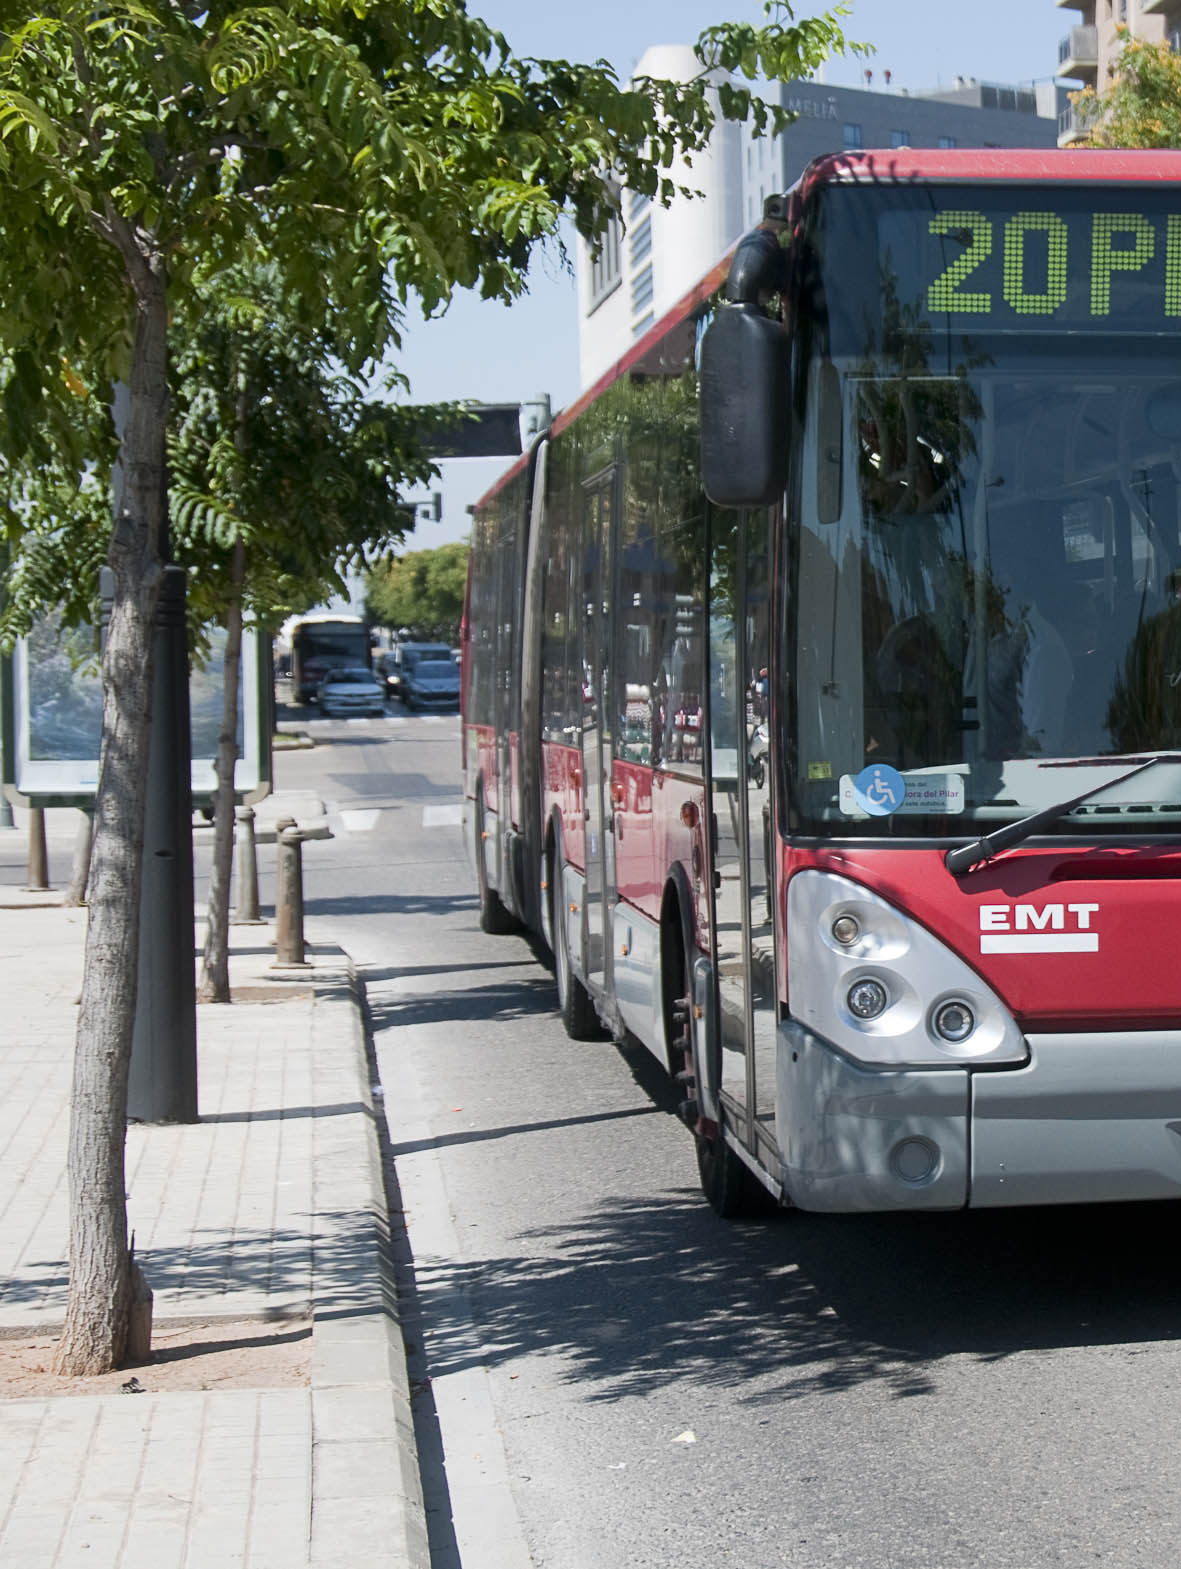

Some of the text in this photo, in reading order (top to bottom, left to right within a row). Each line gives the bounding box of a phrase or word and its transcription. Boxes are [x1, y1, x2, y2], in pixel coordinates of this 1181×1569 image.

[927, 211, 1068, 314] 20
[923, 790, 936, 798] del
[939, 790, 959, 798] Pilar
[980, 903, 1099, 930] EMT
